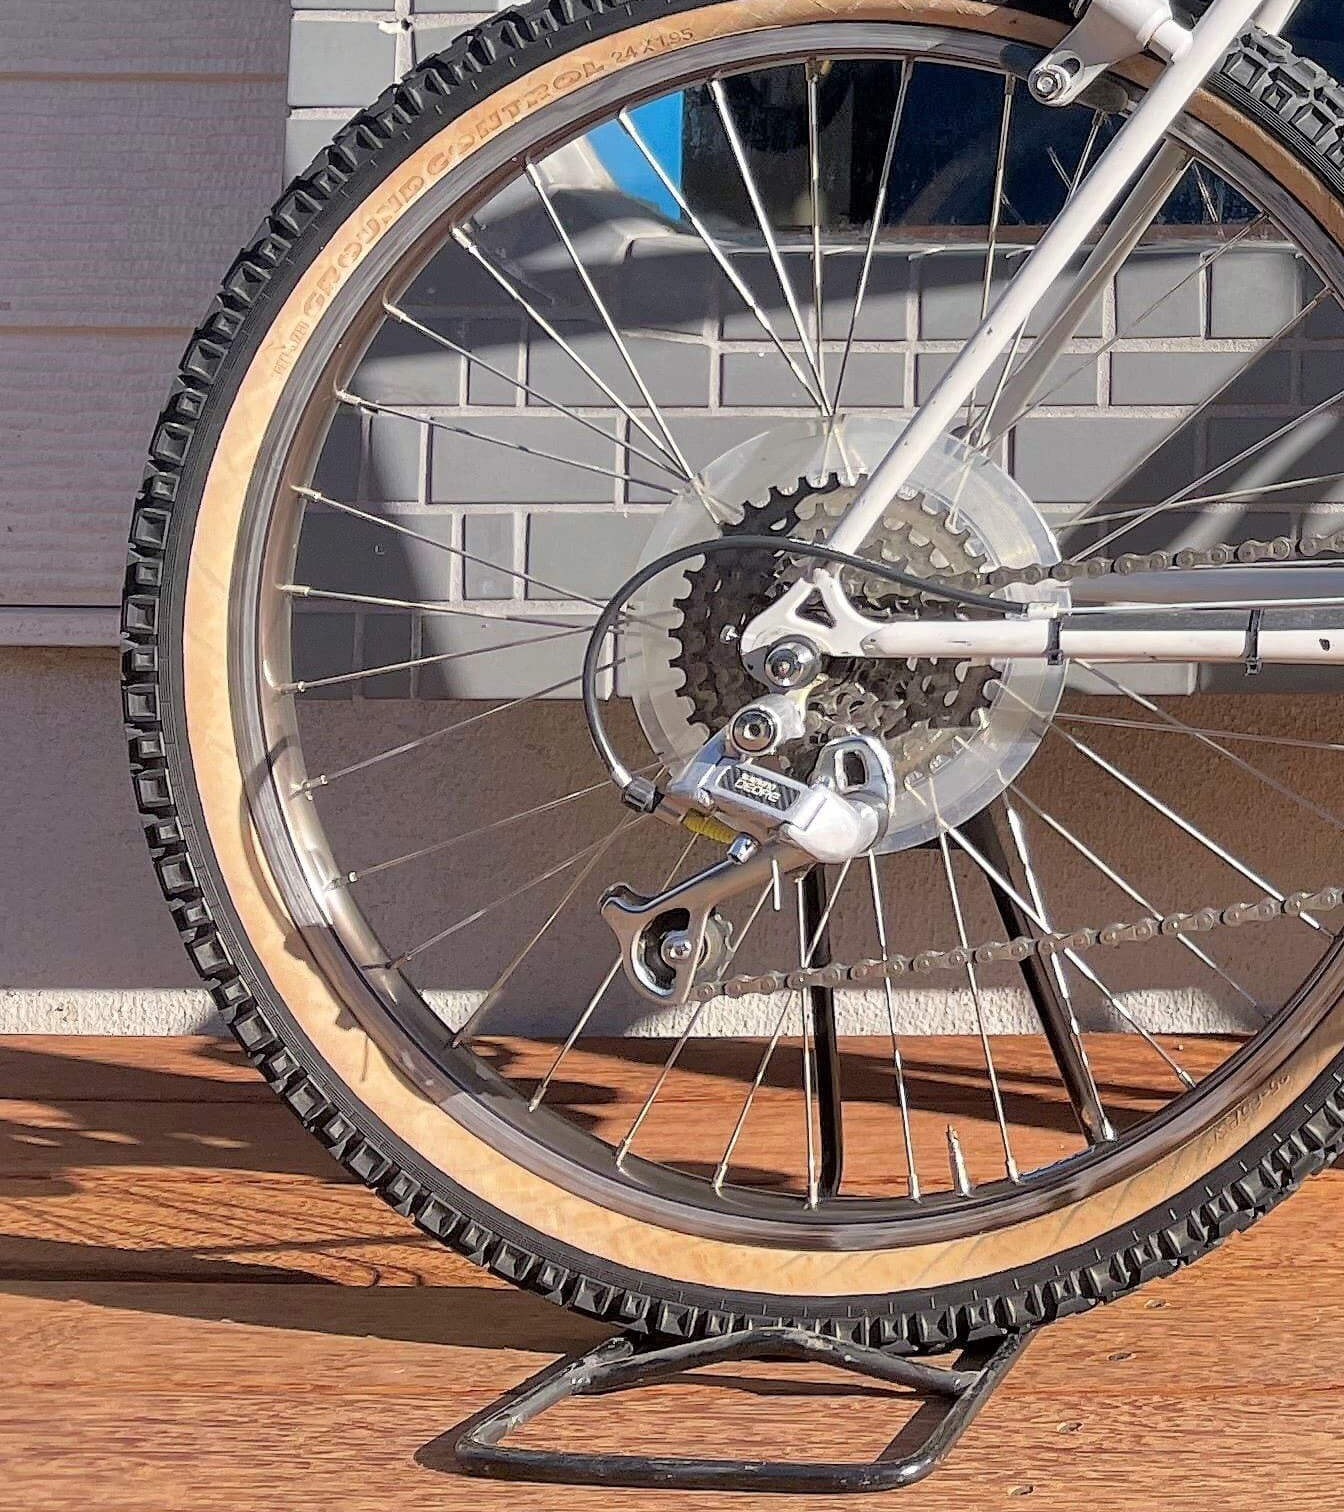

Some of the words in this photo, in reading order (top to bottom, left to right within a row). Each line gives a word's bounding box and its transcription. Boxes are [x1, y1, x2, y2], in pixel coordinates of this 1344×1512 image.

[302, 173, 426, 318] GROUND
[426, 62, 605, 176] CONTROL
[609, 44, 638, 65] 24
